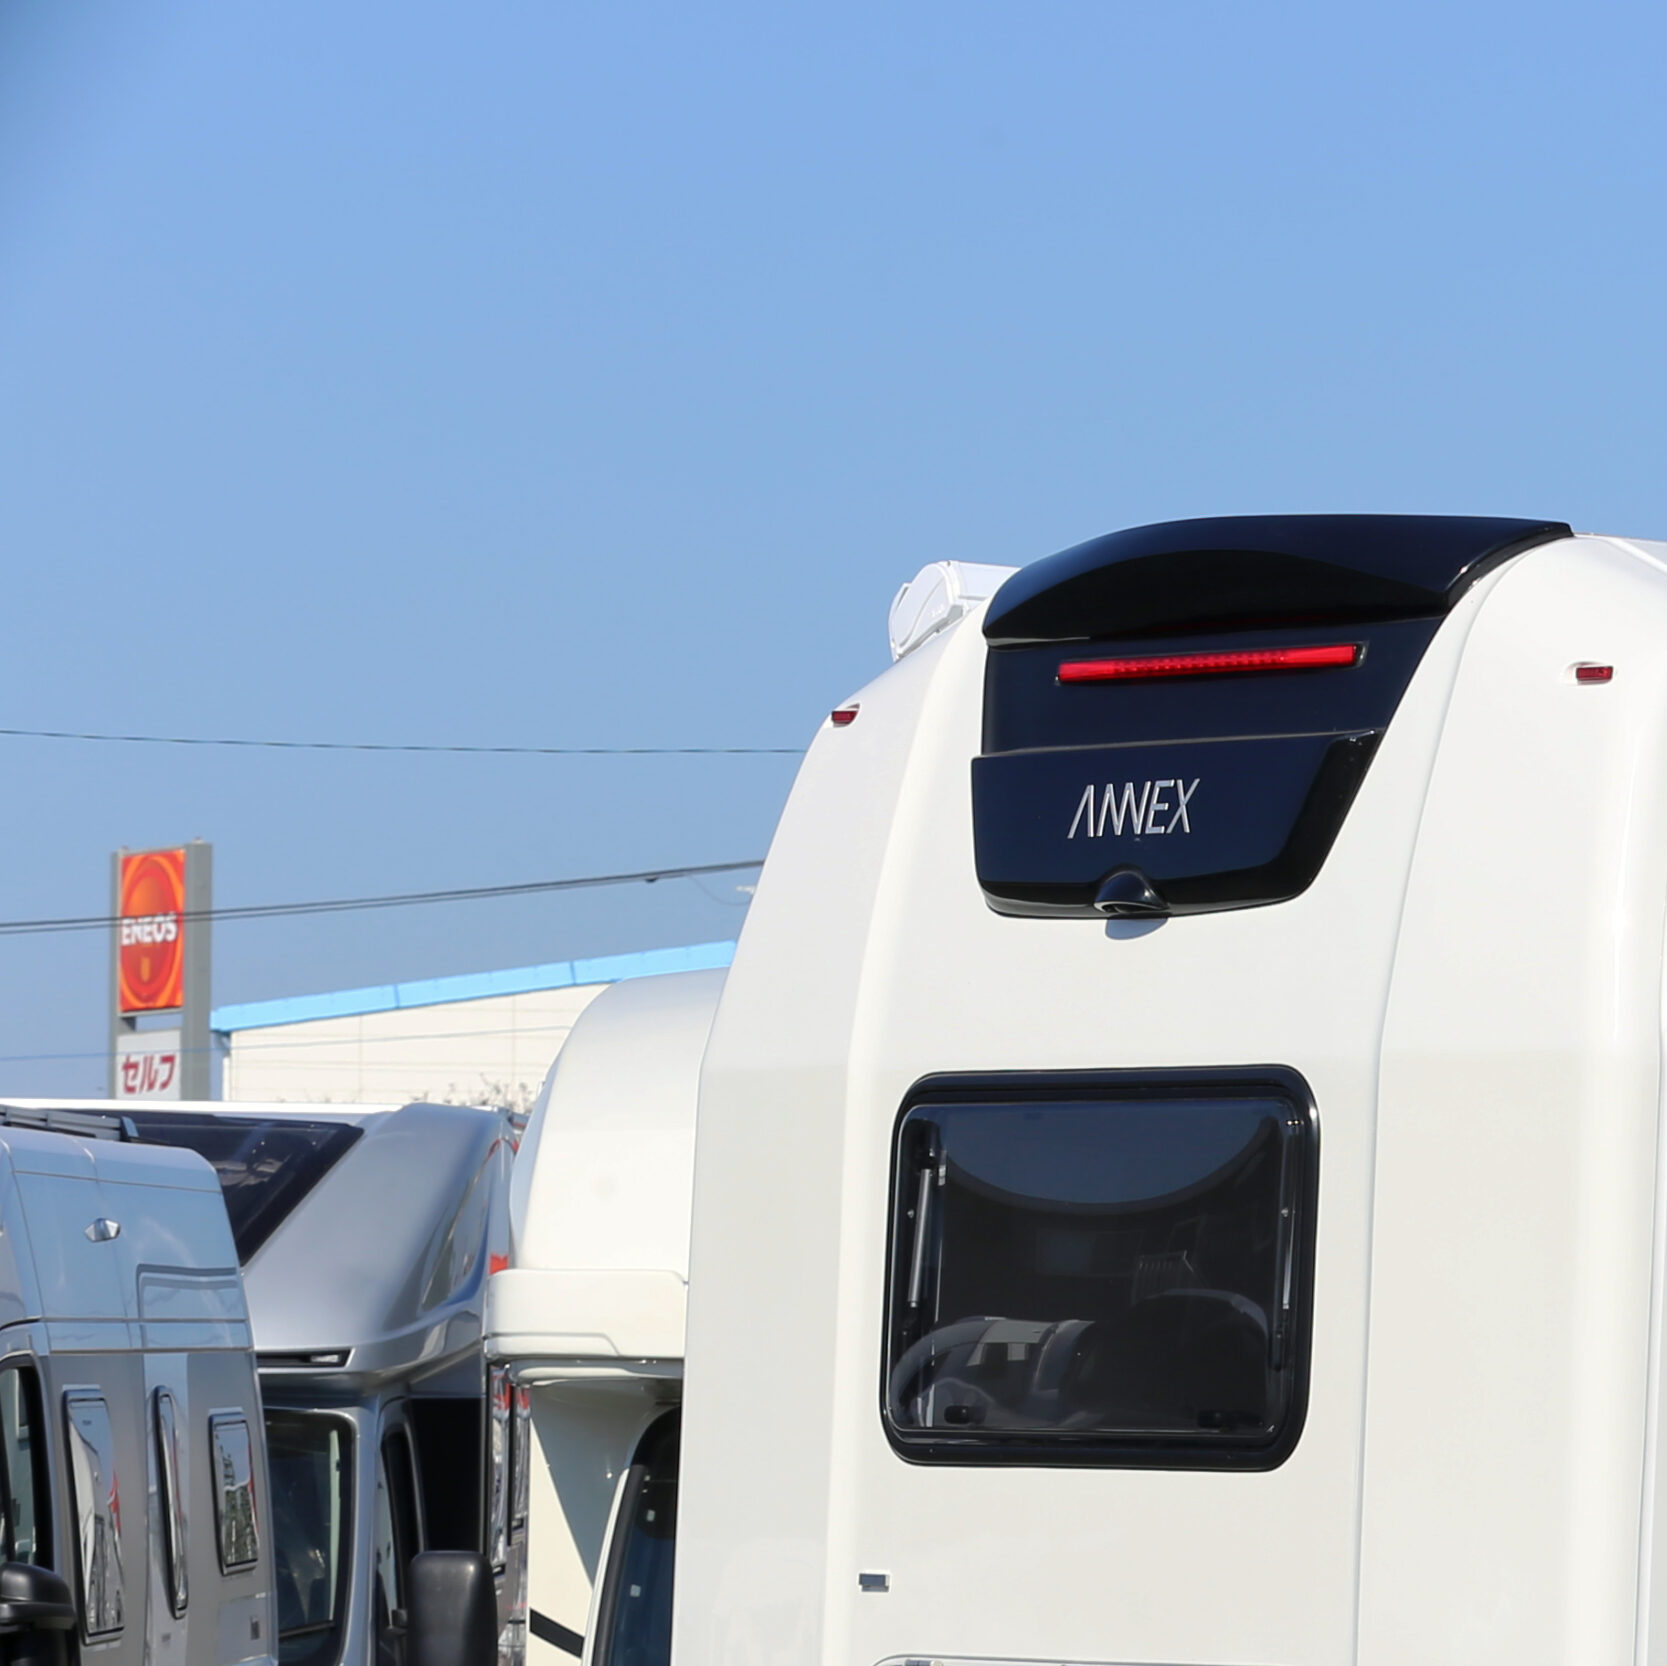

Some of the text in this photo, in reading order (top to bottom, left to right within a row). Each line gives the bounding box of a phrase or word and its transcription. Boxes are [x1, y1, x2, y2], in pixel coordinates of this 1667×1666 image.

[1067, 778, 1200, 839] ANNEX
[121, 912, 178, 946] ENEOS
[121, 1053, 176, 1094] セルフ
